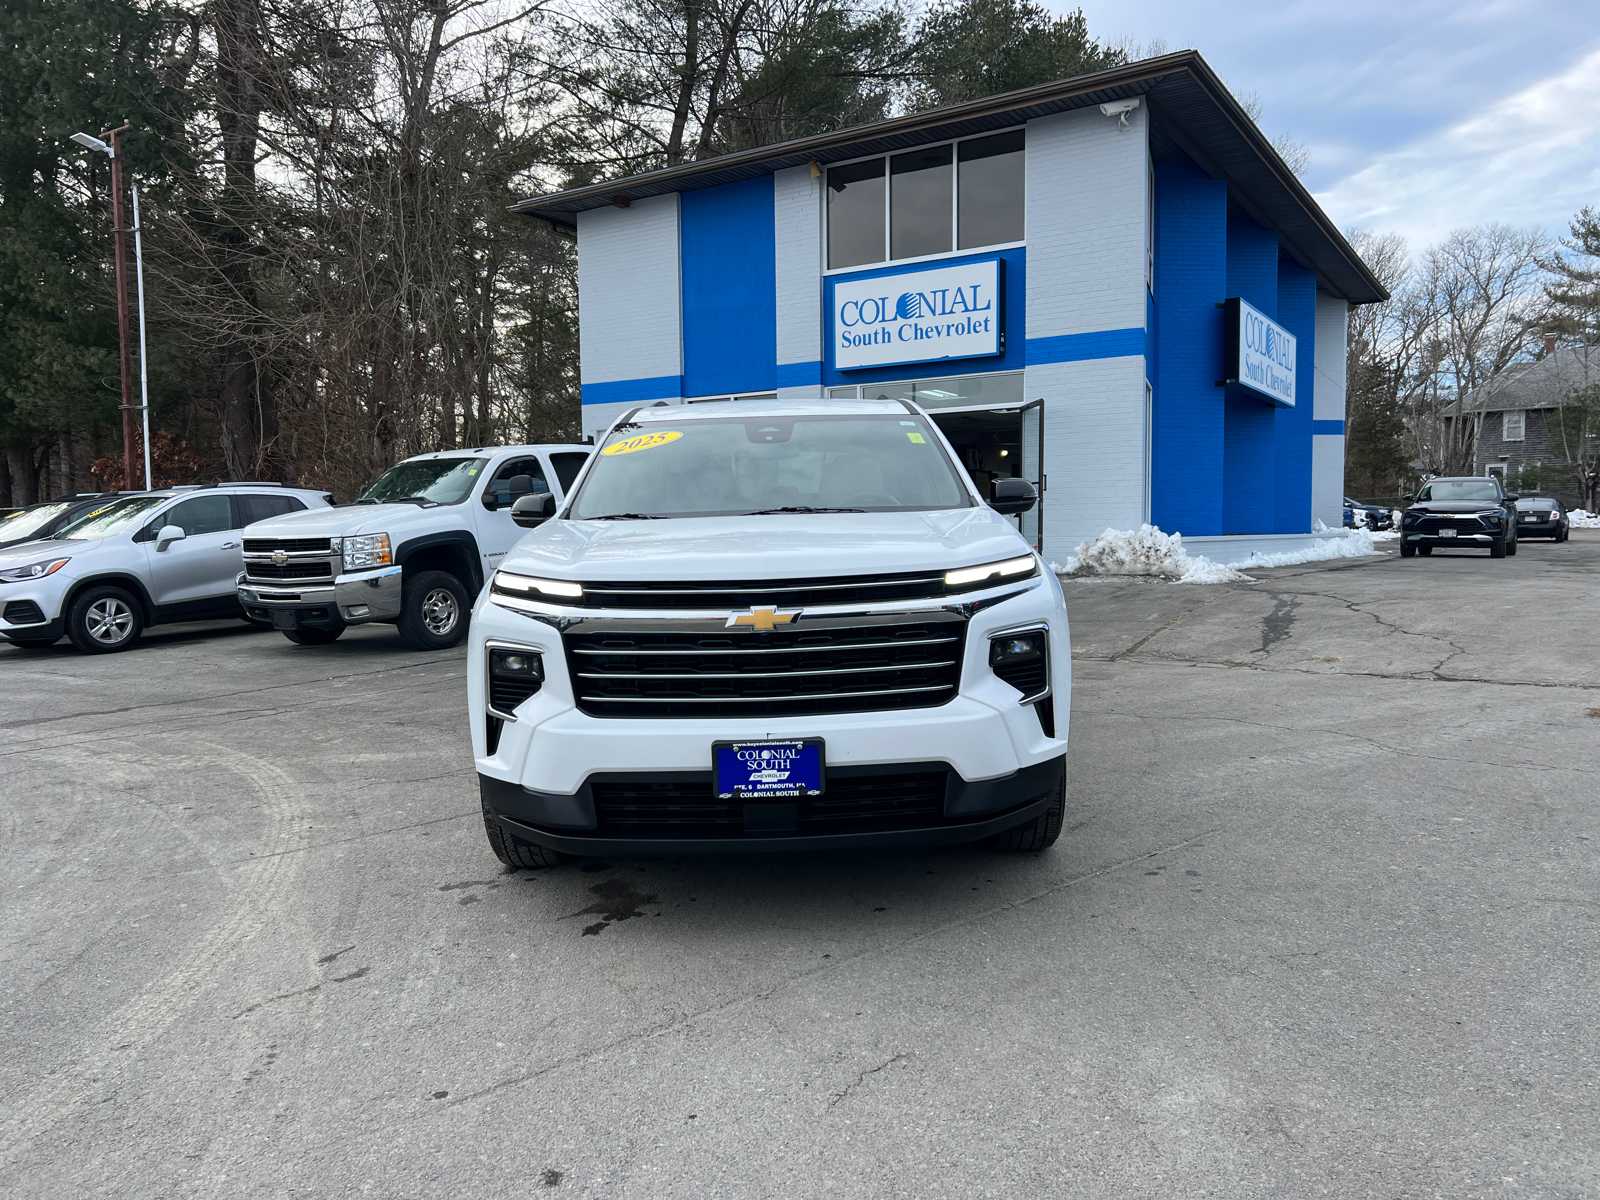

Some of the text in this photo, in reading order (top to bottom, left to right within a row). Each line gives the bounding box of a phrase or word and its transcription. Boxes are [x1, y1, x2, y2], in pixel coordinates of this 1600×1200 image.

[840, 284, 991, 326] COLONIAL
[841, 316, 990, 348] South Chevrolet
[1245, 311, 1293, 372] COLONIAL
[1245, 353, 1292, 398] South Chevrolet
[614, 432, 668, 453] 2025
[737, 749, 800, 760] COLONIAL
[747, 760, 791, 770] SOUTH
